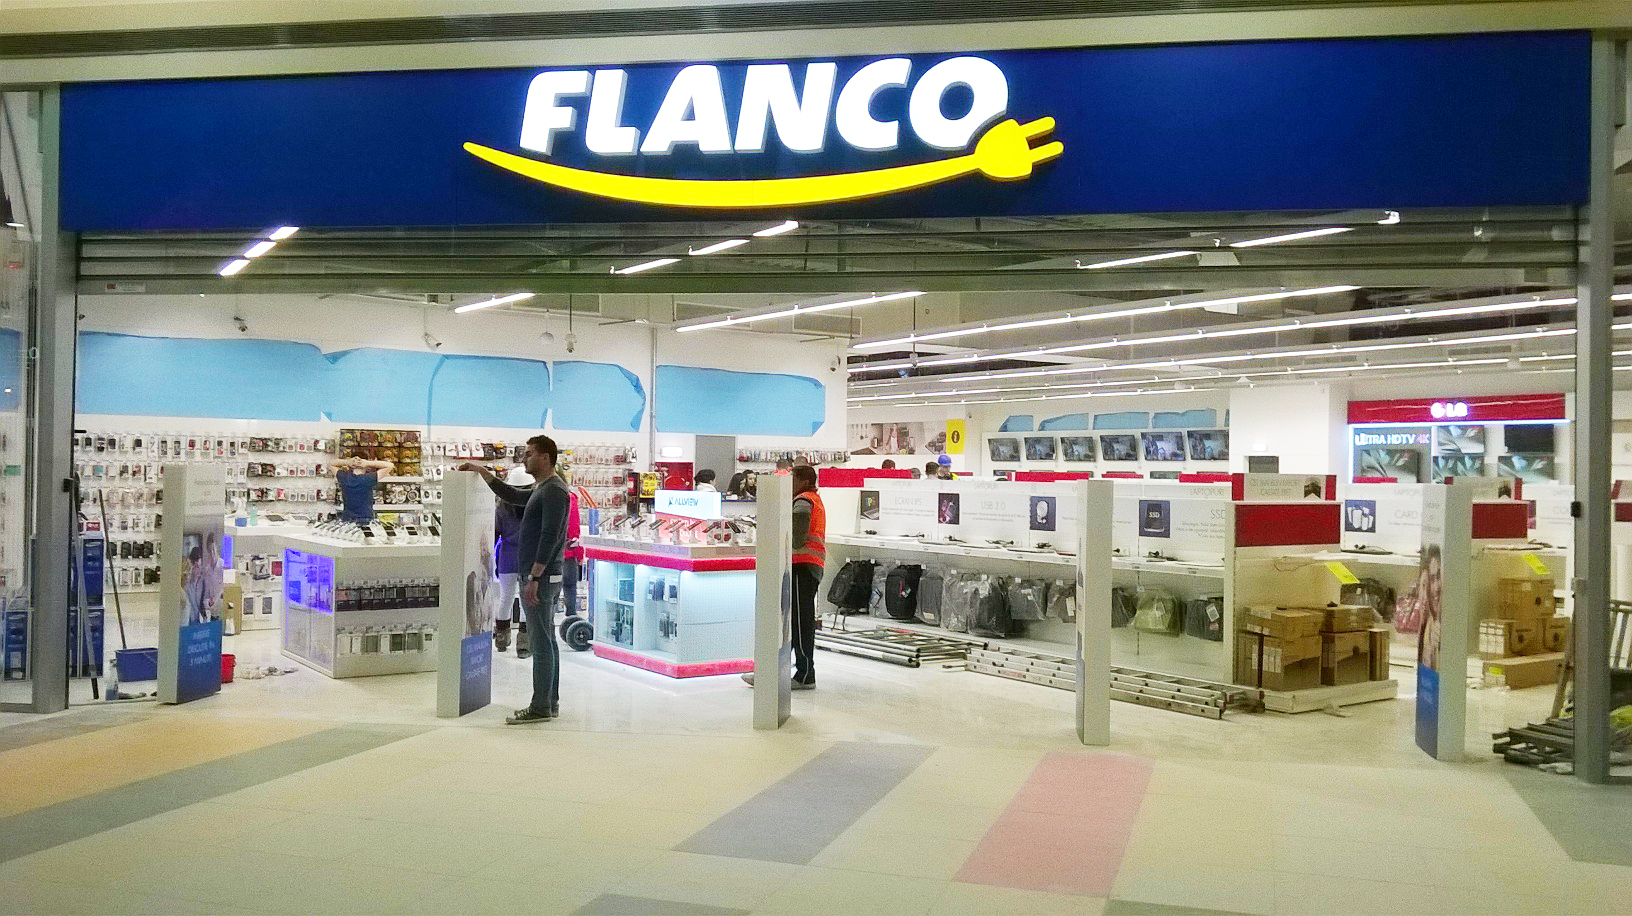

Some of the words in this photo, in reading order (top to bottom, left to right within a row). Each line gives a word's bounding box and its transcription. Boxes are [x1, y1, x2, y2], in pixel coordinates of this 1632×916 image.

[519, 56, 1009, 156] FLANCO
[1388, 433, 1416, 445] HDTV
[674, 497, 699, 507] ALLVIEW
